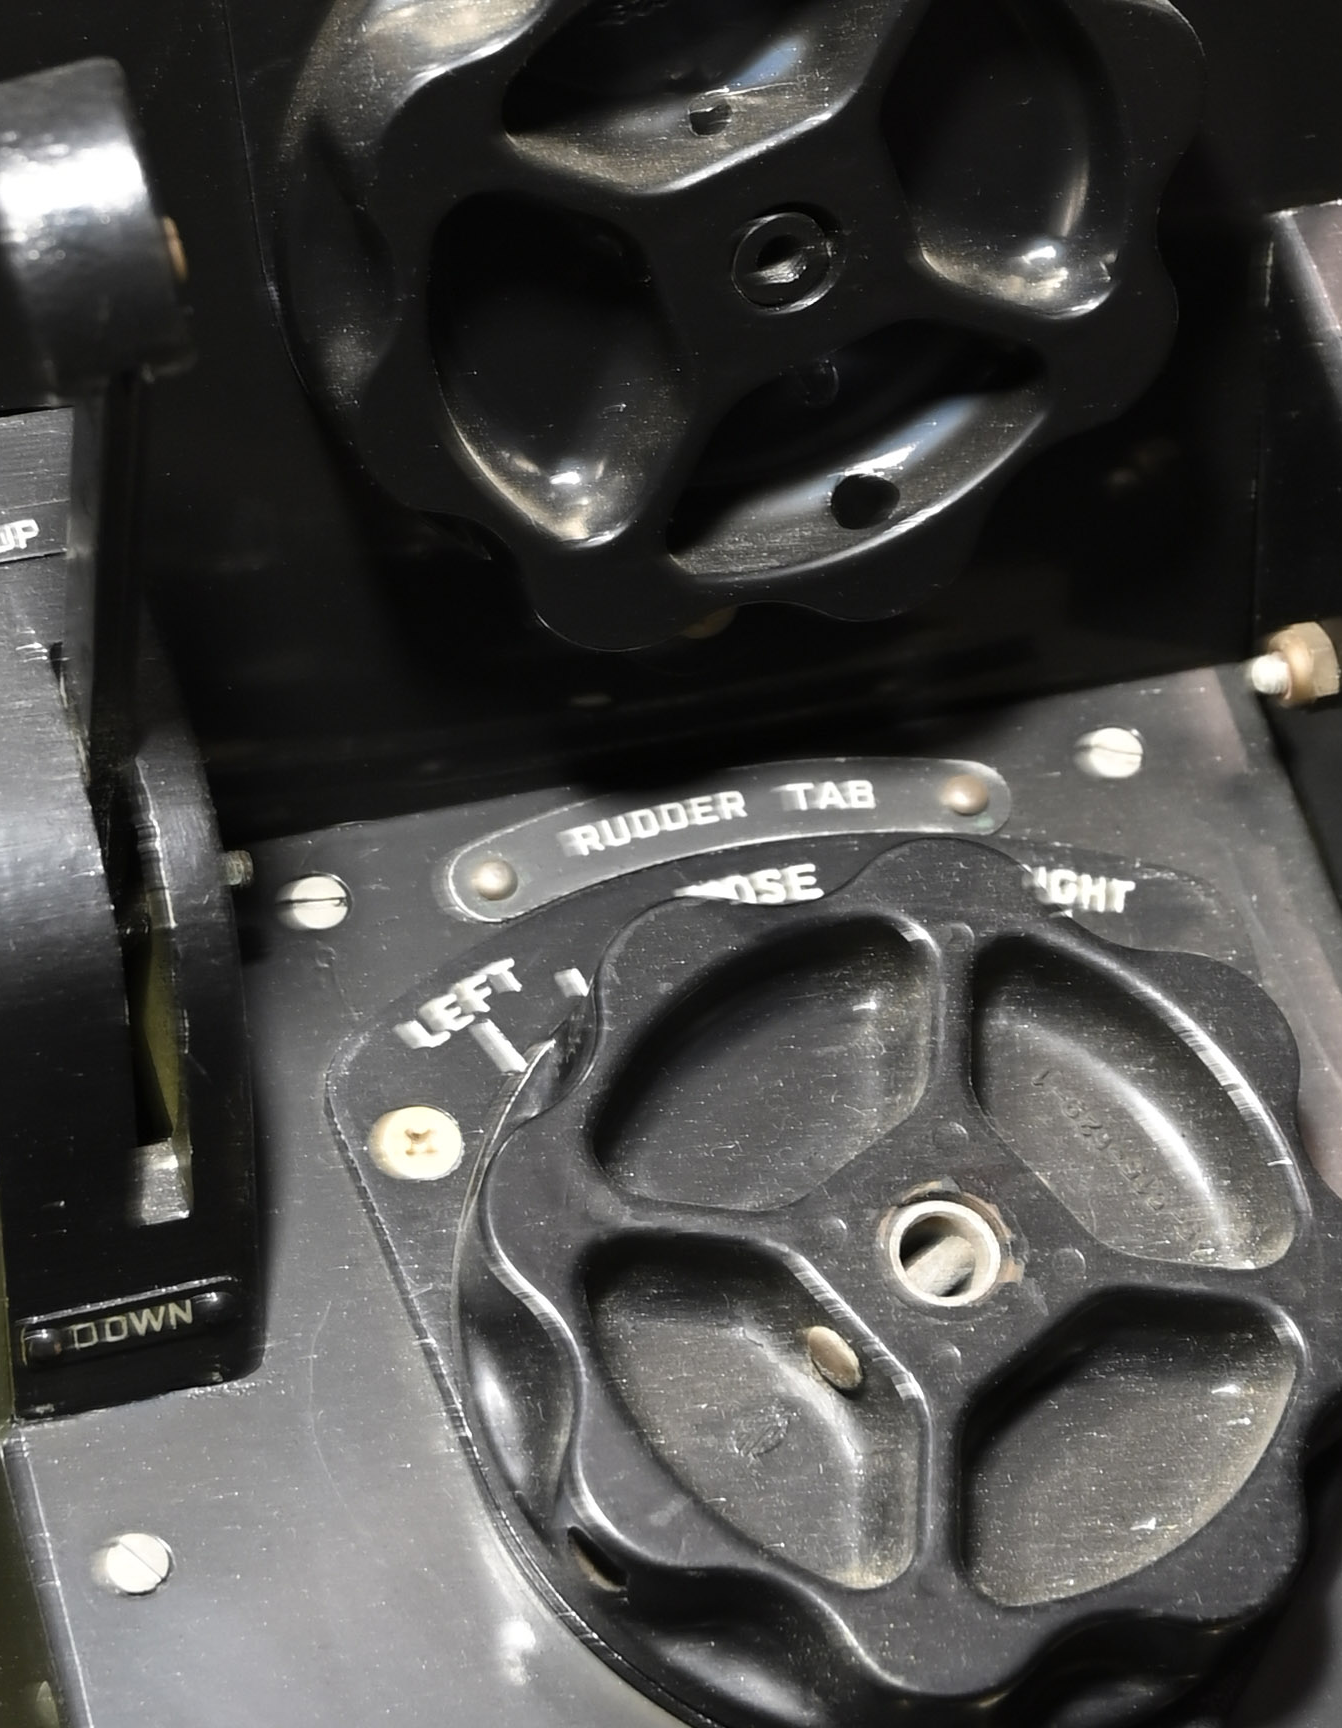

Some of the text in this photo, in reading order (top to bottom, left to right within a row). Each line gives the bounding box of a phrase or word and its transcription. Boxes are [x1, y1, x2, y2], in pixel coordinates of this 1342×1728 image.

[559, 779, 877, 858] RUDDER TAB
[1022, 863, 1136, 915] IGHT
[393, 957, 523, 1050] LEFT
[70, 1298, 194, 1351] DOWN
